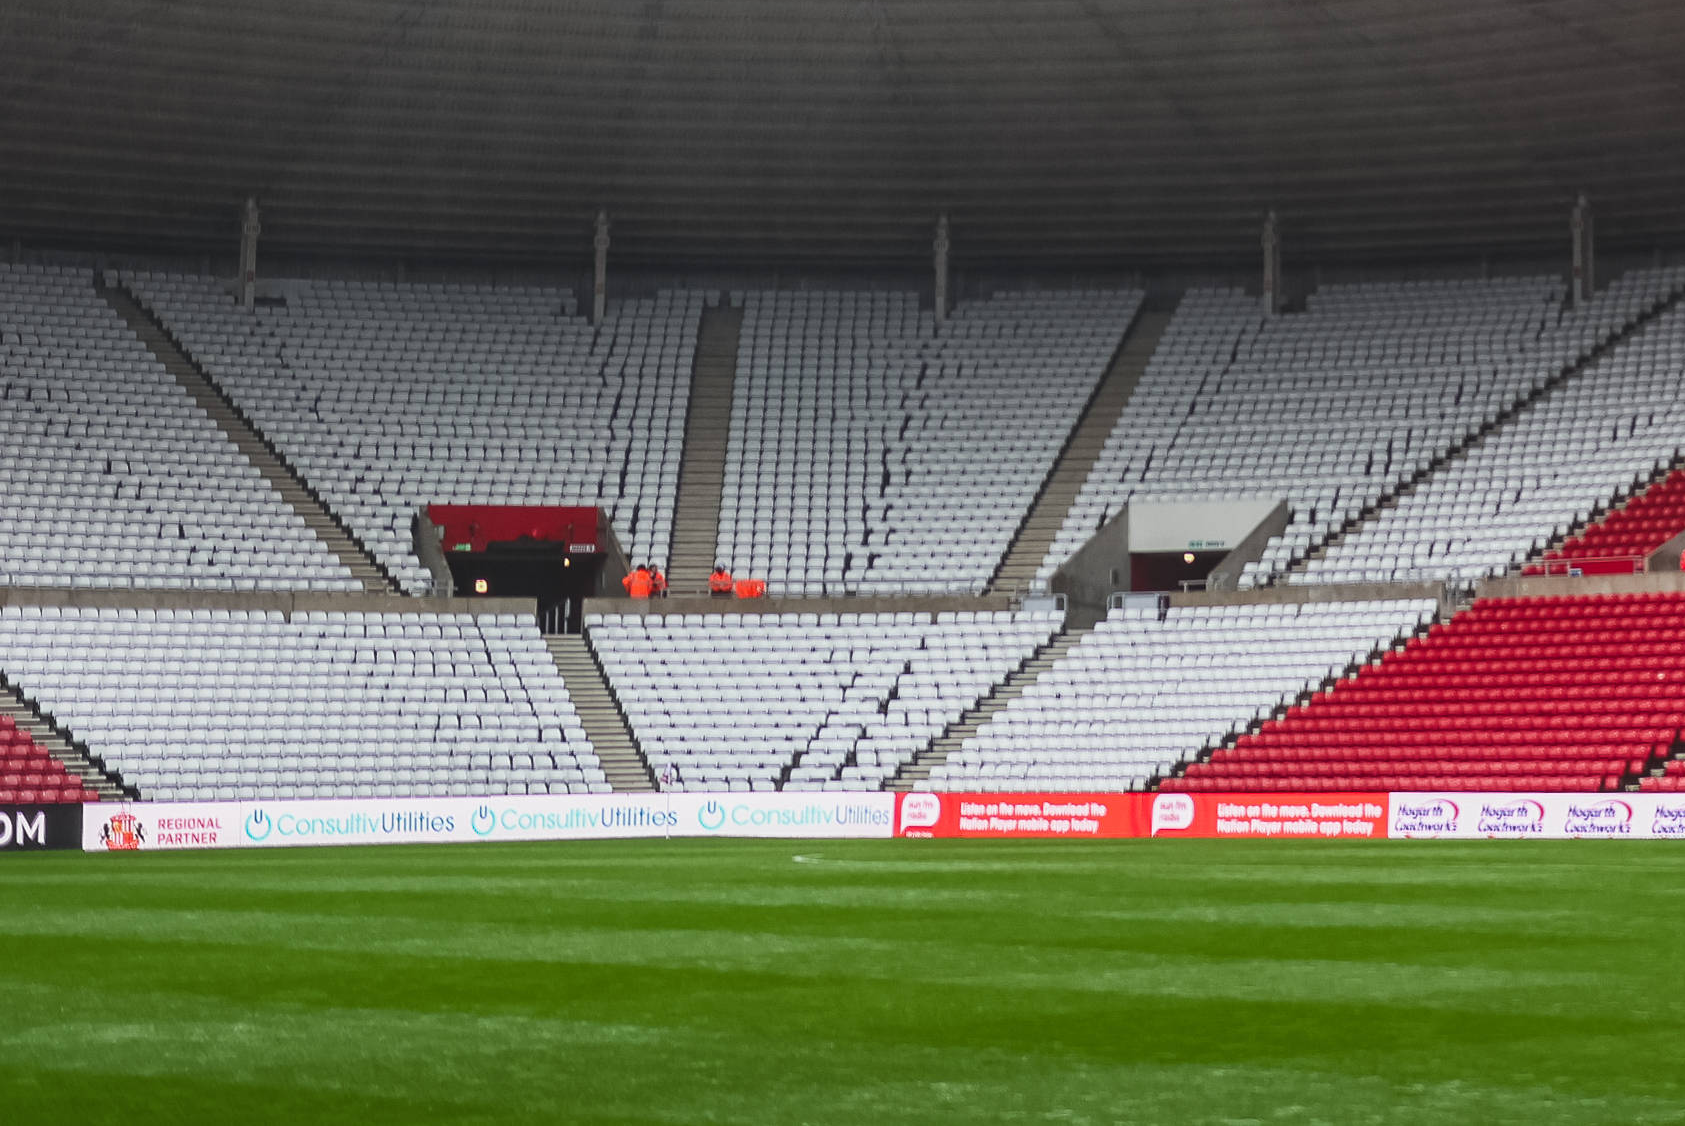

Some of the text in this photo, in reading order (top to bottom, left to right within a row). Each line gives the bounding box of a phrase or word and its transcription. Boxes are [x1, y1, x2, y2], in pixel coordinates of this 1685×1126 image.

[731, 803, 890, 826] ConsultivUtilities
[960, 802, 986, 816] Listen
[986, 804, 999, 816] on
[999, 802, 1014, 816] the
[1042, 802, 1090, 816] Download
[1090, 802, 1108, 816] the
[1216, 803, 1246, 818] Listen
[1246, 805, 1261, 818] on
[1261, 803, 1278, 818] the
[1311, 803, 1363, 818] Download
[1364, 803, 1383, 818] the
[1397, 804, 1443, 820] Hogarth
[1480, 804, 1528, 820] Hogarth
[1567, 804, 1616, 820] Hogarth
[157, 817, 222, 830] REGIONAL
[277, 811, 455, 836] ConsultivUtilities
[500, 805, 678, 831] ConsultivUtilities
[959, 817, 989, 831] Nation
[989, 817, 1017, 833] Player
[1017, 817, 1049, 831] mobile
[1050, 819, 1070, 834] app
[1216, 818, 1250, 834] Nation
[1250, 819, 1282, 836] Player
[1283, 819, 1318, 834] mobile
[1319, 821, 1342, 837] app
[157, 832, 218, 845] PARTNER
